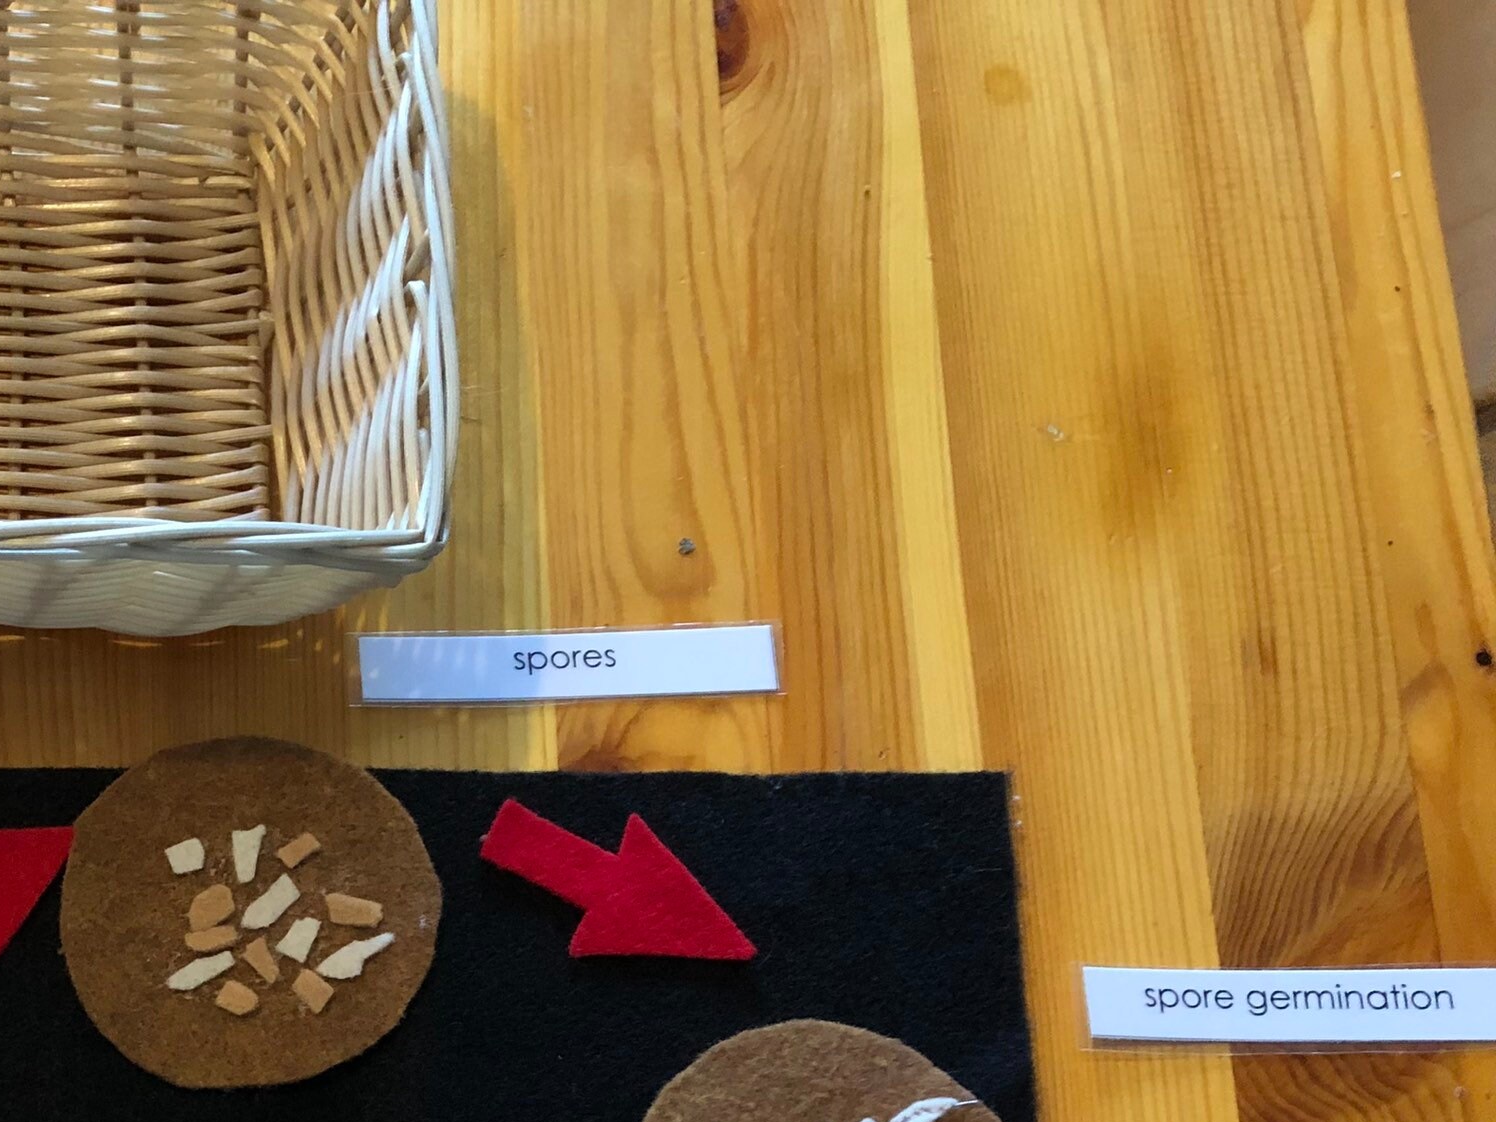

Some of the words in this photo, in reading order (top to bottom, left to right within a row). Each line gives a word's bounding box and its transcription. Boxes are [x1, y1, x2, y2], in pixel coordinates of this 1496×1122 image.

[513, 646, 616, 675] spores
[1144, 986, 1234, 1012] spore
[1246, 984, 1455, 1015] germination
